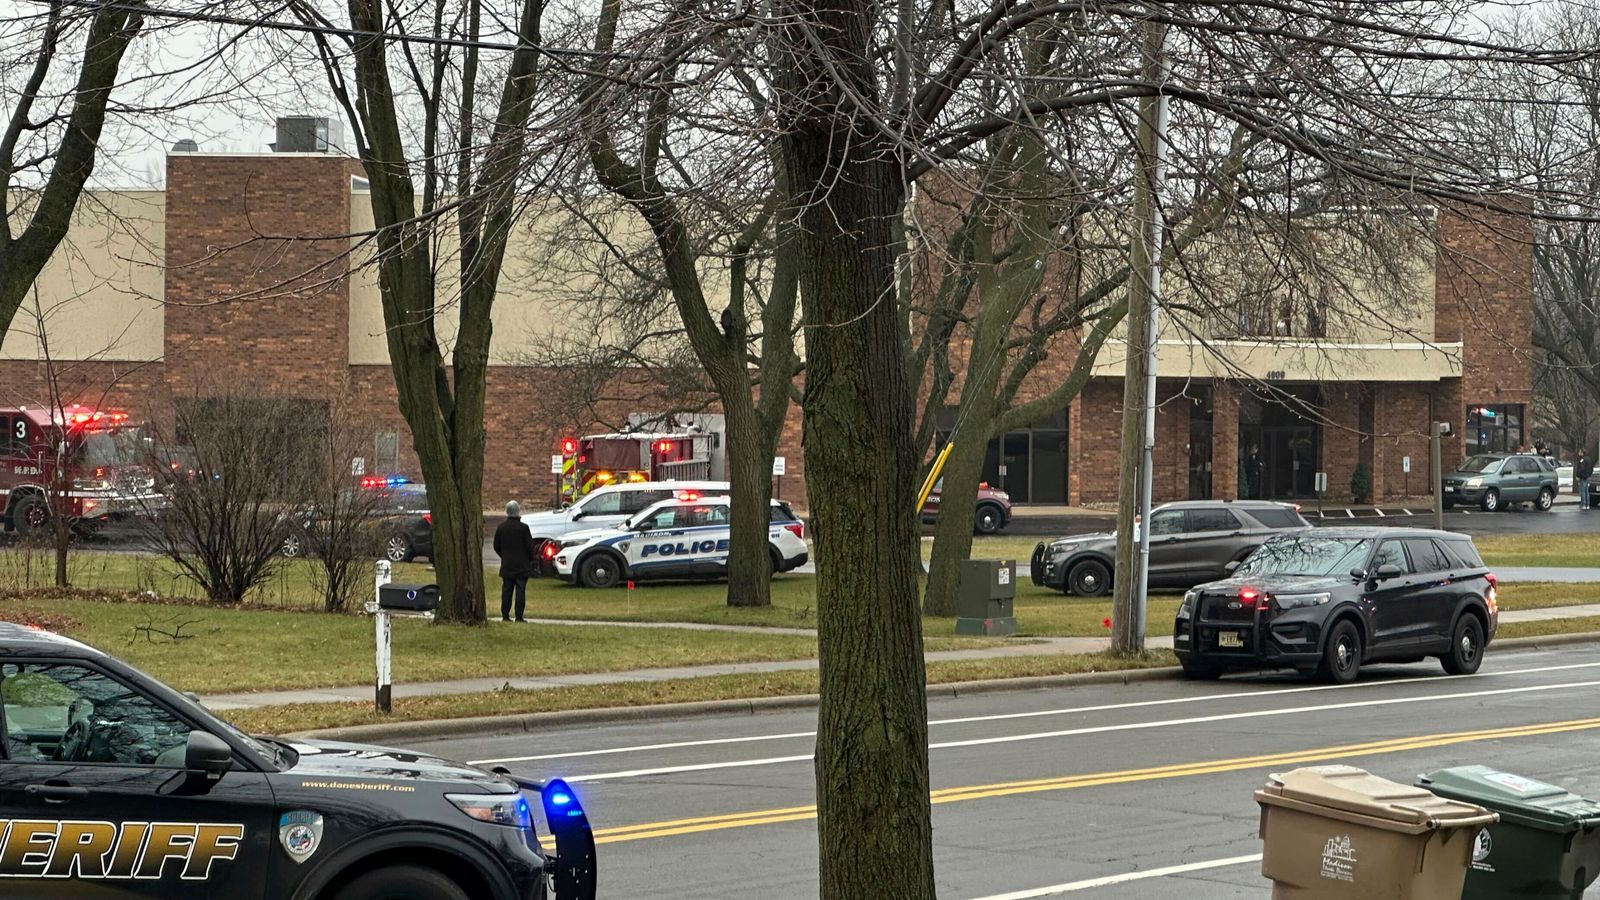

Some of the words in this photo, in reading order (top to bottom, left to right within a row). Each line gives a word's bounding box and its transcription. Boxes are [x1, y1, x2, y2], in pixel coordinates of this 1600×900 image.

[16, 421, 26, 439] 3
[642, 539, 729, 557] POLICE
[302, 781, 415, 792] www.danesheriff.com
[0, 819, 244, 879] ERIFF
